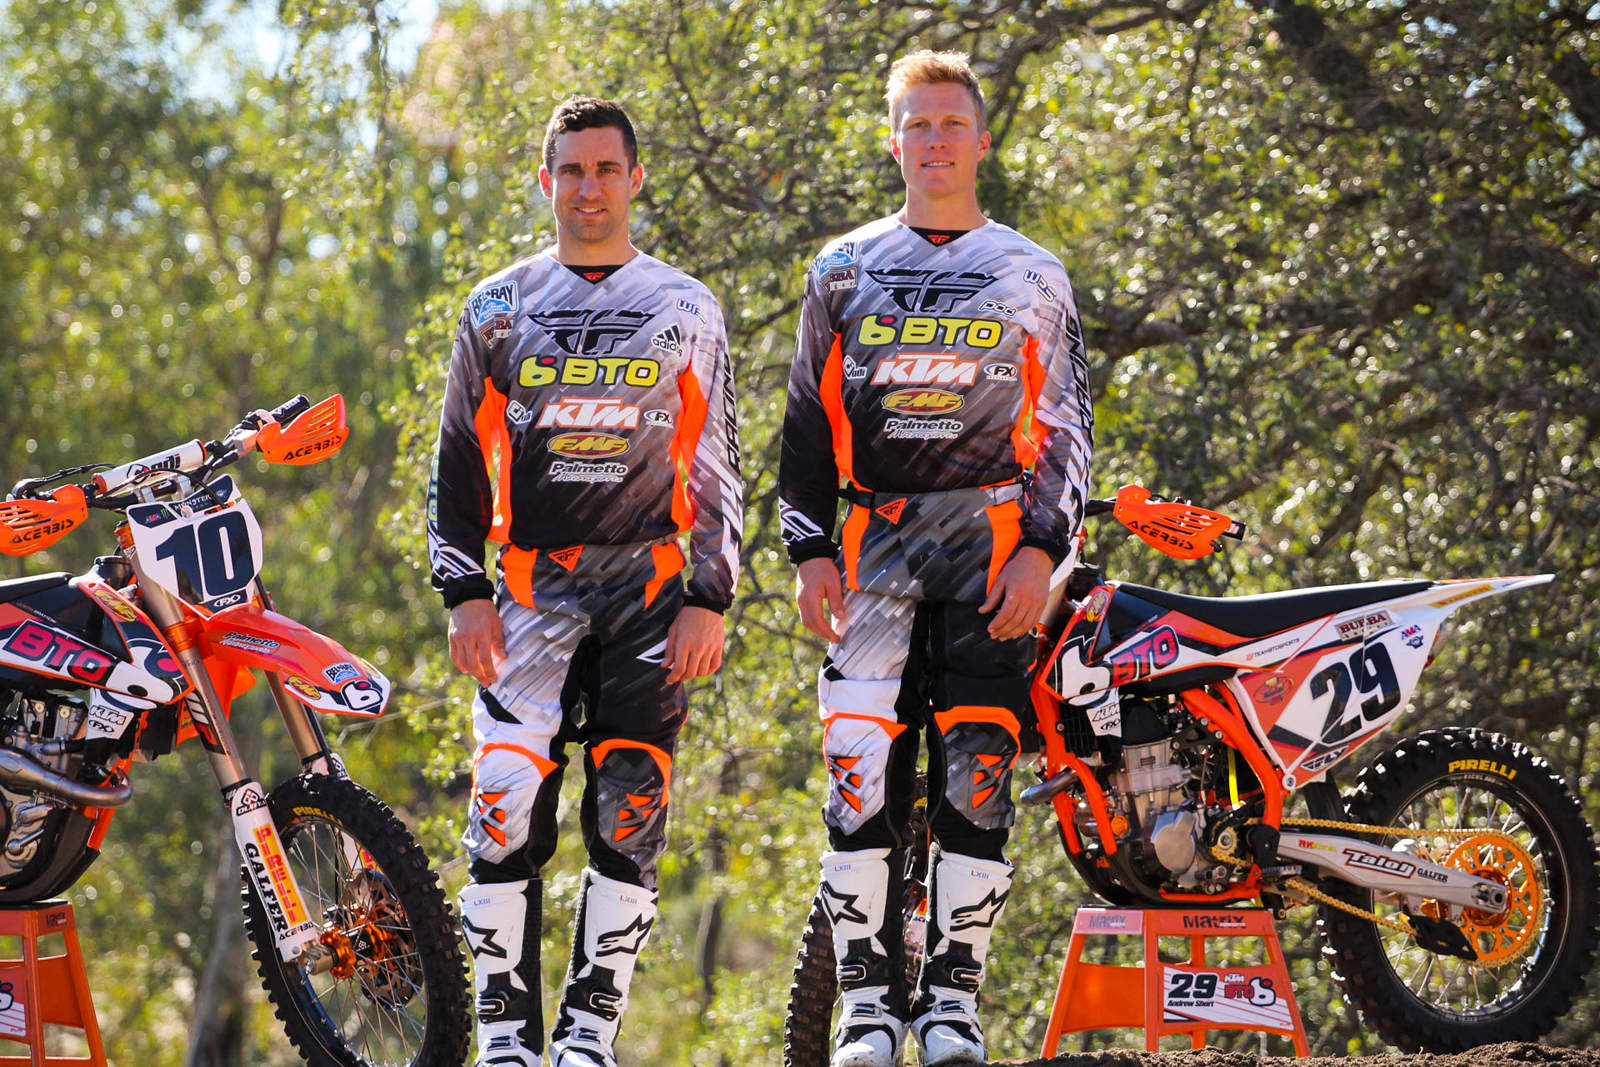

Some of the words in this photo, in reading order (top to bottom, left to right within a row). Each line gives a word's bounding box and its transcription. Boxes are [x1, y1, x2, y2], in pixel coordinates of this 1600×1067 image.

[899, 316, 1003, 348] BTO
[560, 357, 660, 387] BTO
[872, 354, 978, 384] KTM
[886, 393, 962, 407] FMF
[537, 398, 639, 428] KTM
[885, 419, 963, 431] Palmetto
[552, 437, 627, 451] FMF
[550, 462, 628, 475] Palmetto
[10, 519, 74, 544] ACERBIS
[1127, 520, 1194, 550] ACERBIS
[155, 511, 255, 604] 10
[223, 631, 281, 648] Palmetto
[1401, 624, 1421, 640] AMA
[5, 622, 113, 682] BTO
[1111, 627, 1178, 687] BTO
[1310, 642, 1401, 744] 29
[89, 705, 127, 725] KTM
[1448, 759, 1517, 780] PIRELLI
[292, 806, 344, 827] PIRELLI
[256, 827, 297, 923] PIRELLI
[1345, 849, 1416, 878] Talon
[1417, 868, 1448, 883] GALFER
[244, 842, 289, 932] GALFER
[1168, 973, 1218, 999] 29
[1224, 973, 1245, 983] KTM
[1194, 1000, 1215, 1008] Short
[1224, 984, 1255, 999] BTO
